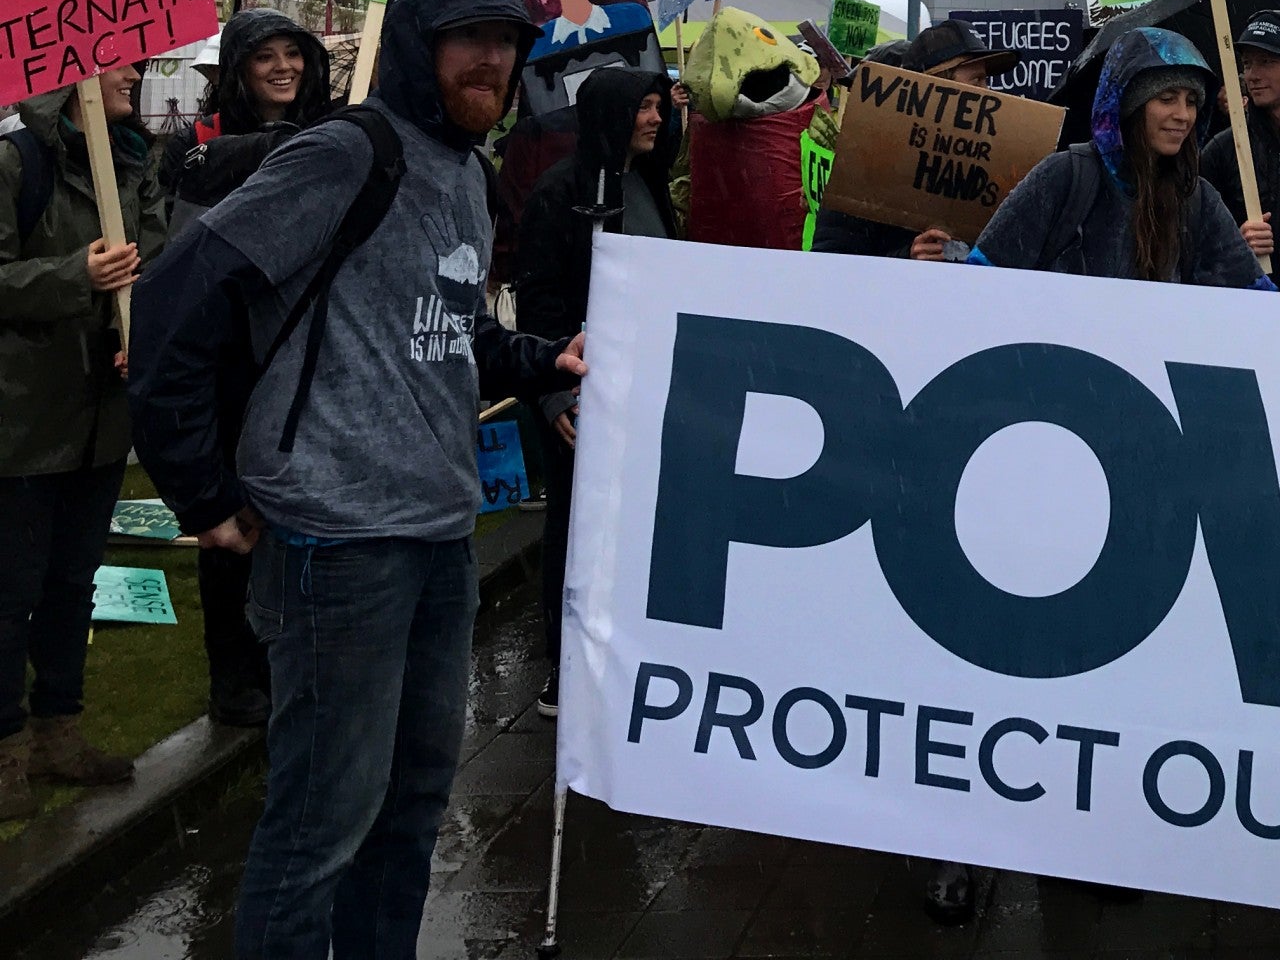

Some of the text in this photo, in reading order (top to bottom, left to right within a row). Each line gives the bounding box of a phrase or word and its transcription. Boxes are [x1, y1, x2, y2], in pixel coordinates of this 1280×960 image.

[953, 137, 992, 161] OUR
[913, 150, 1000, 207] HANDS
[409, 335, 425, 362] IS
[426, 333, 447, 362] IN
[124, 576, 168, 616] SENSE
[626, 661, 1120, 813] PROTECT
